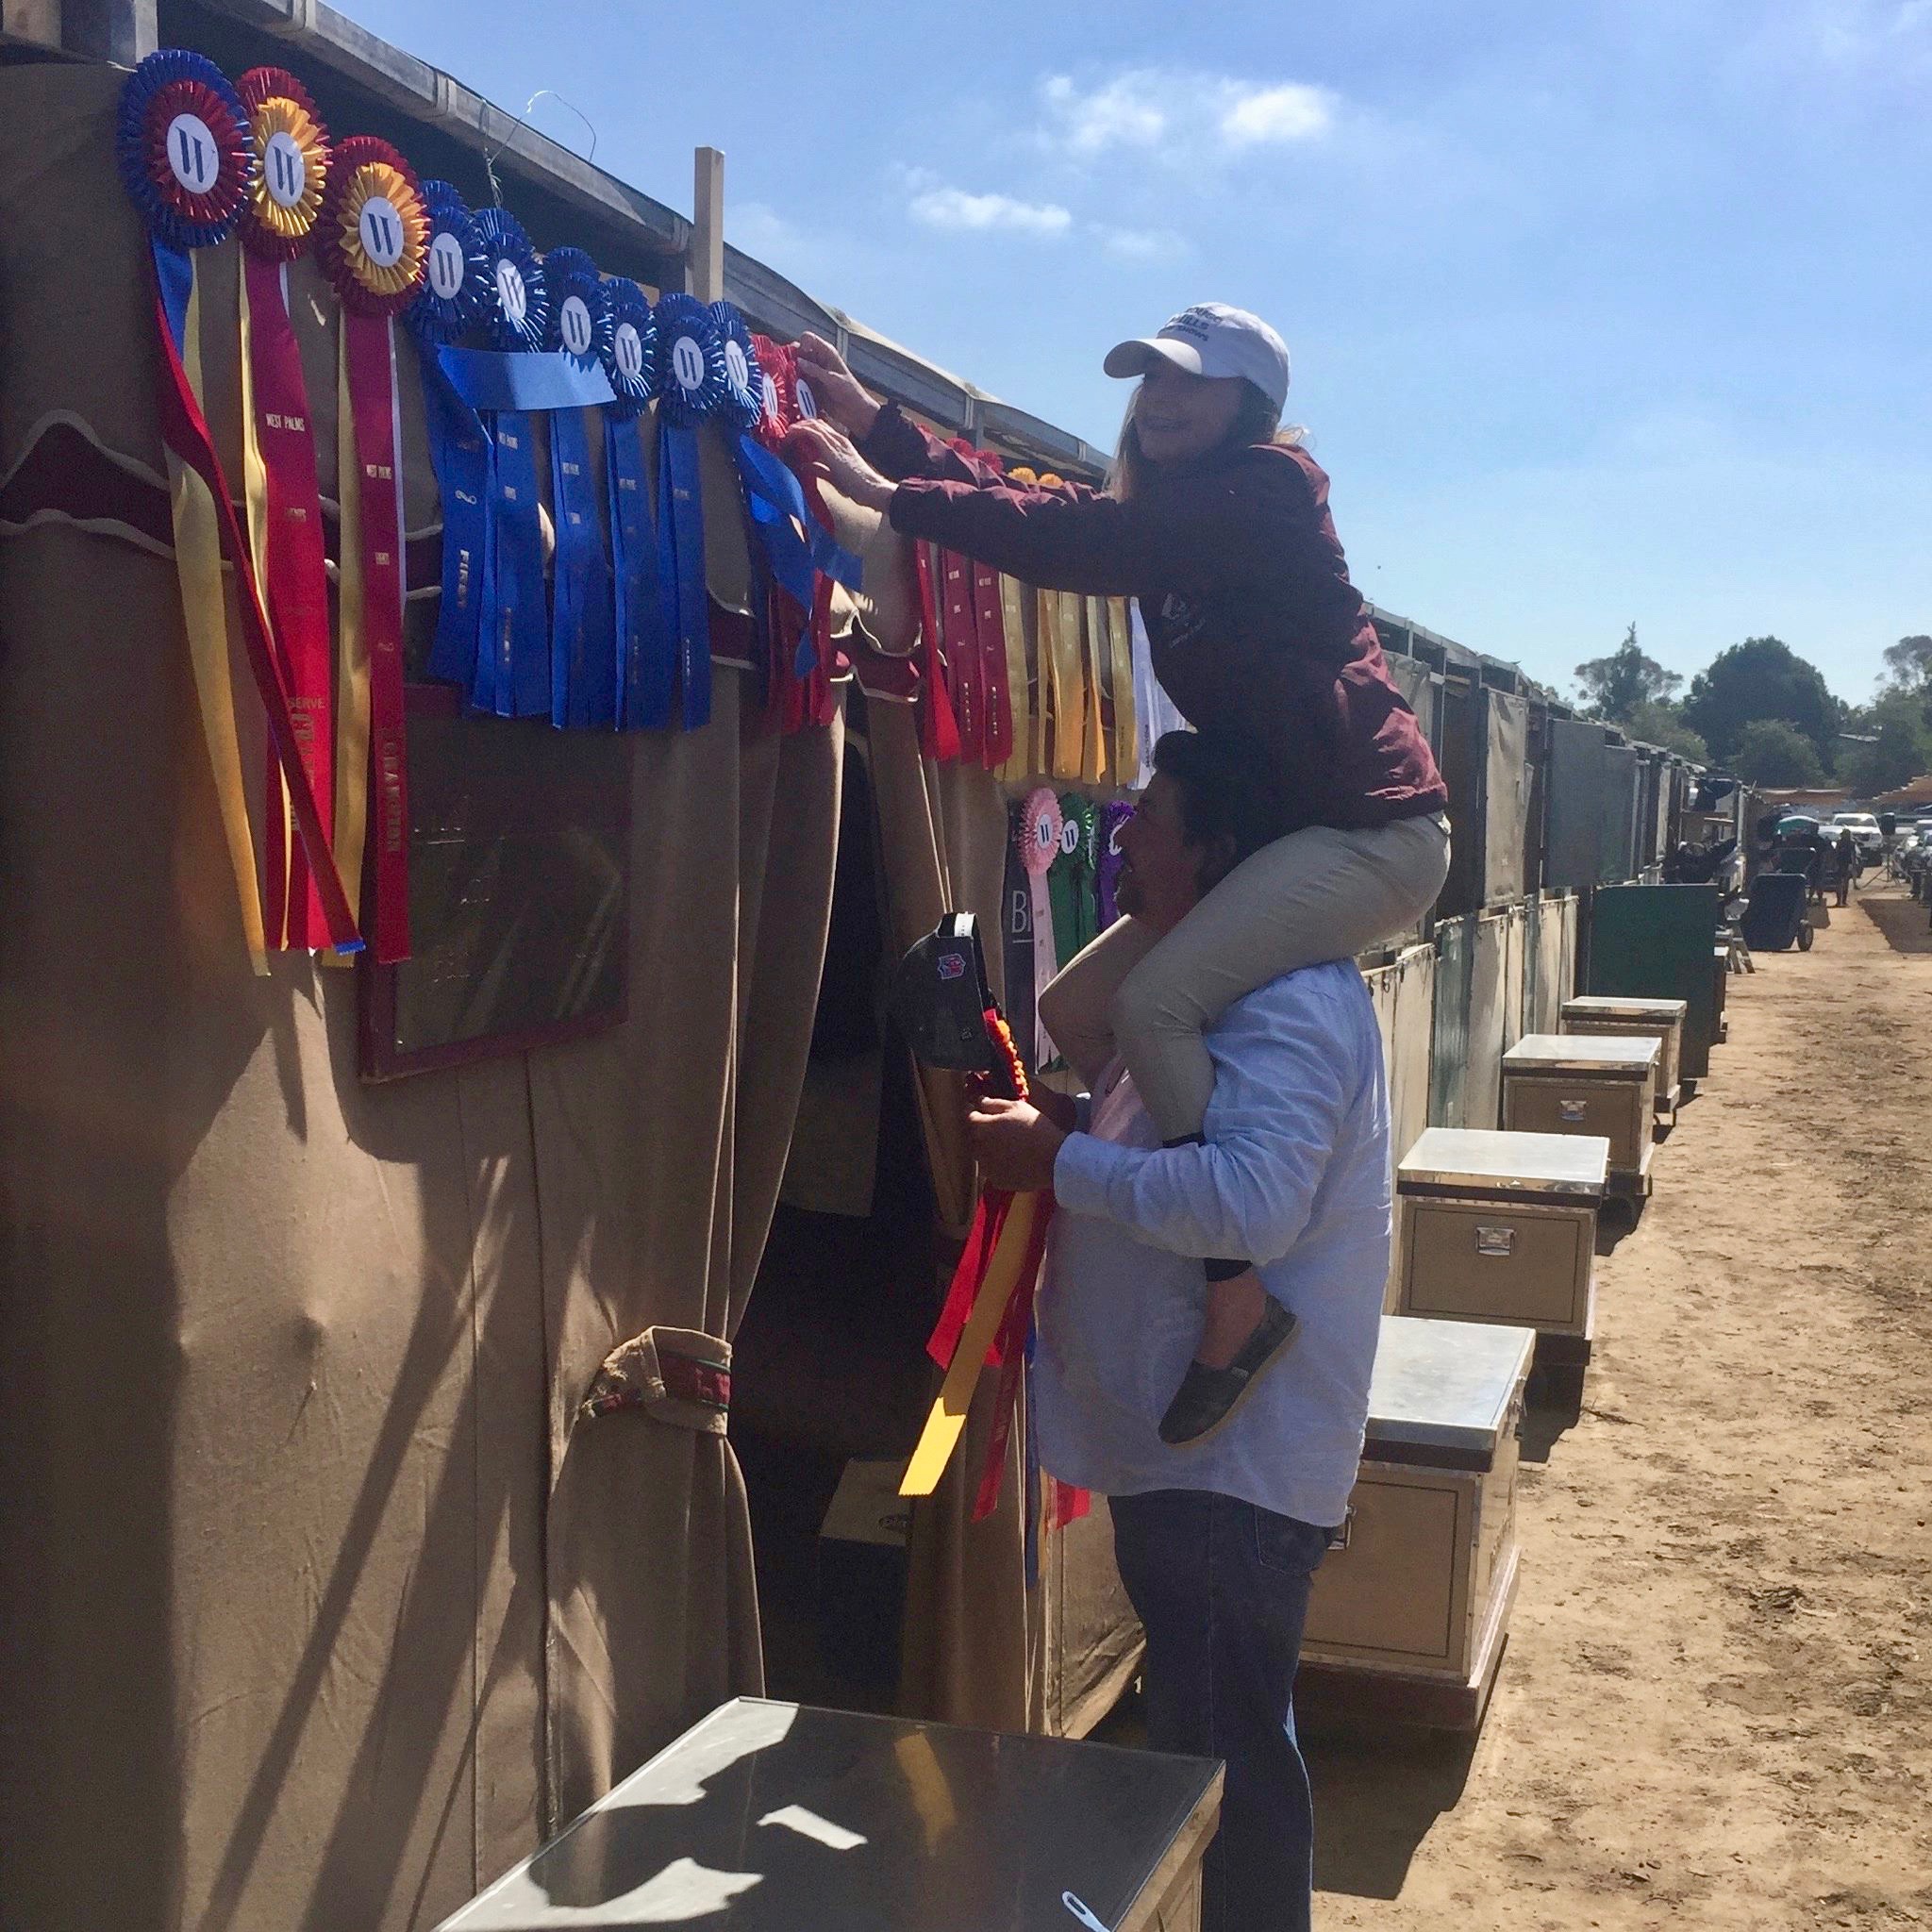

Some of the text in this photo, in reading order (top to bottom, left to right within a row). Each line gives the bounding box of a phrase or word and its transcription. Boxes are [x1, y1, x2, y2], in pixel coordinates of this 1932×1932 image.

[265, 413, 305, 432] WEST PALMS
[287, 696, 325, 709] SERVE
